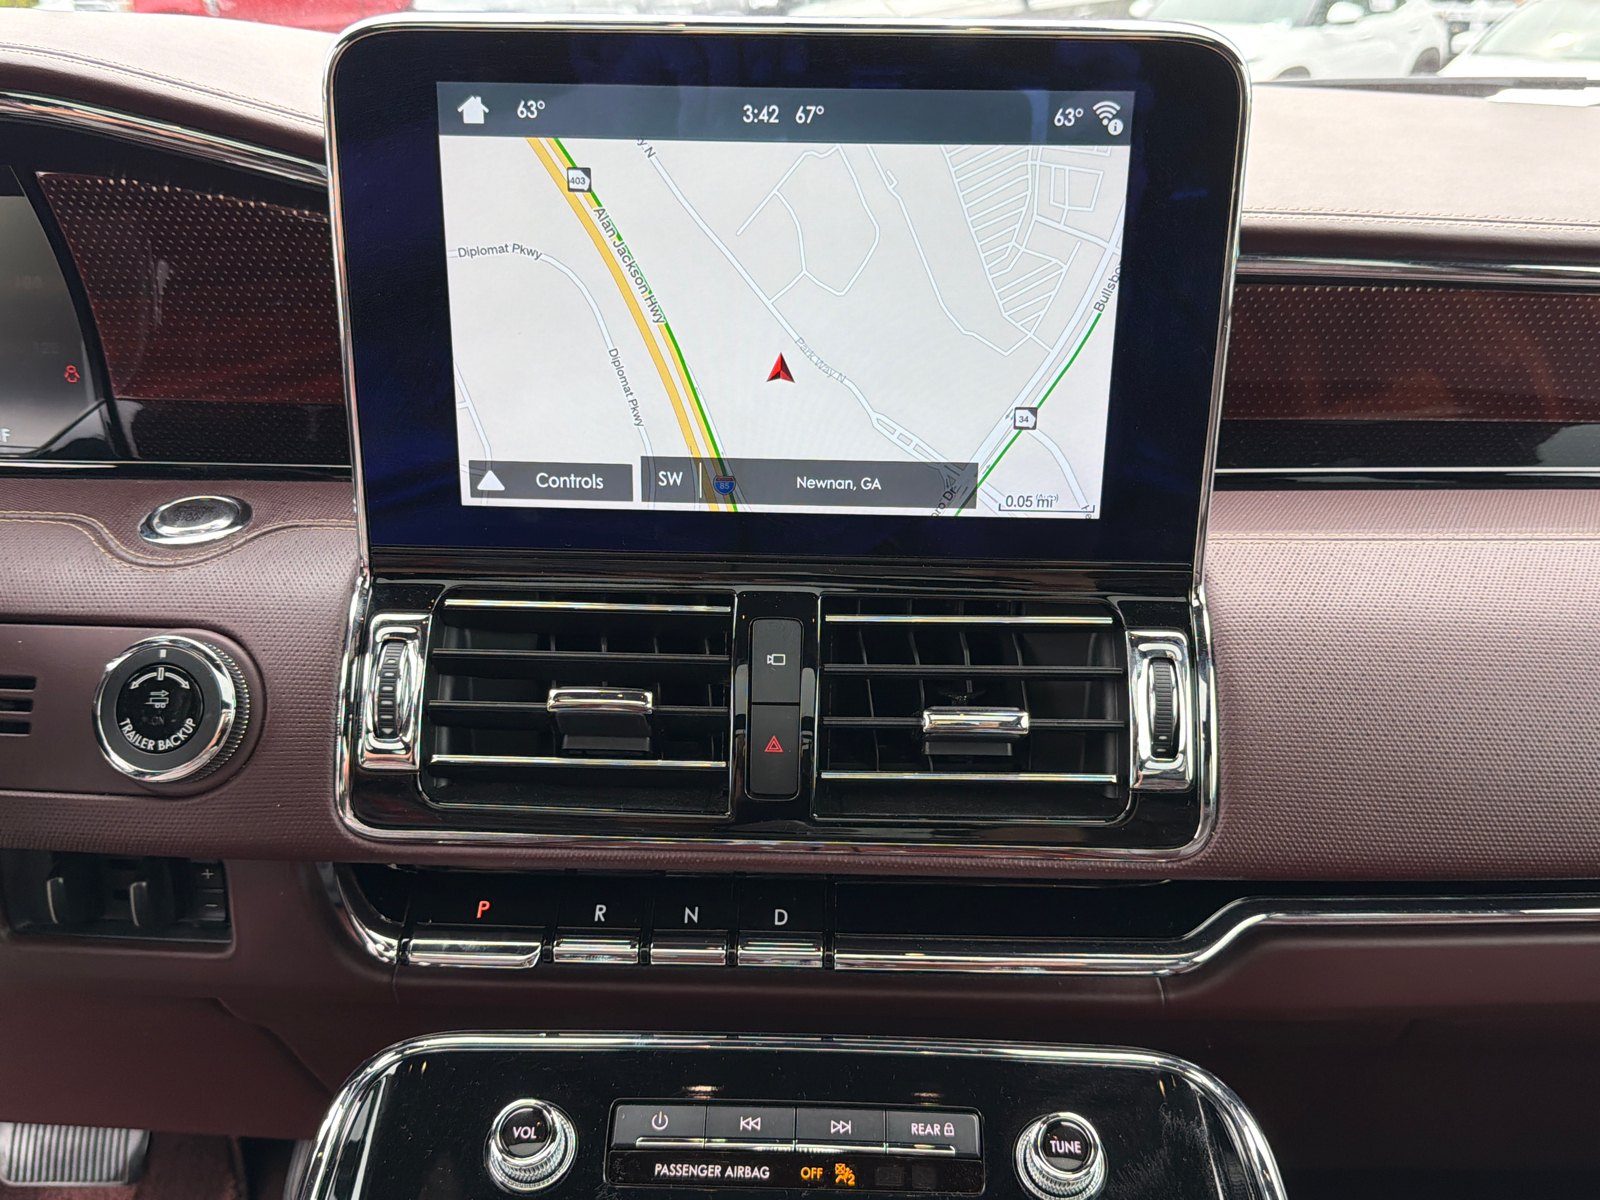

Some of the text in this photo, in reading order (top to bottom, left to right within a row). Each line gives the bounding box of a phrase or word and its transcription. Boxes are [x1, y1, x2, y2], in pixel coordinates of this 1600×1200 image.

[517, 100, 546, 119] 63°
[743, 105, 825, 124] 3:42 67°
[1054, 107, 1084, 127] 63°
[569, 176, 586, 186] 403
[458, 242, 543, 261] Diplomat Pkwy
[593, 207, 665, 325] Alan Jackson Hwy
[813, 358, 837, 381] Way
[608, 348, 645, 428] Diplomat Pkwy
[1018, 415, 1030, 424] 34
[536, 472, 604, 490] Controls
[658, 471, 684, 487] SW
[719, 482, 730, 490] 85
[796, 476, 882, 492] Newnan, GA
[1005, 494, 1033, 508] 0.05
[1036, 496, 1053, 508] mi
[119, 717, 197, 751] TRAILER BACKUP
[476, 900, 490, 918] P
[594, 904, 607, 922] R
[684, 906, 698, 924] N
[774, 909, 788, 926] D
[512, 1126, 537, 1140] VOL
[911, 1122, 941, 1136] REAR
[1050, 1140, 1082, 1154] TUNE
[654, 1163, 770, 1179] PASSENGER AIRBAG
[801, 1166, 824, 1180] OFF
